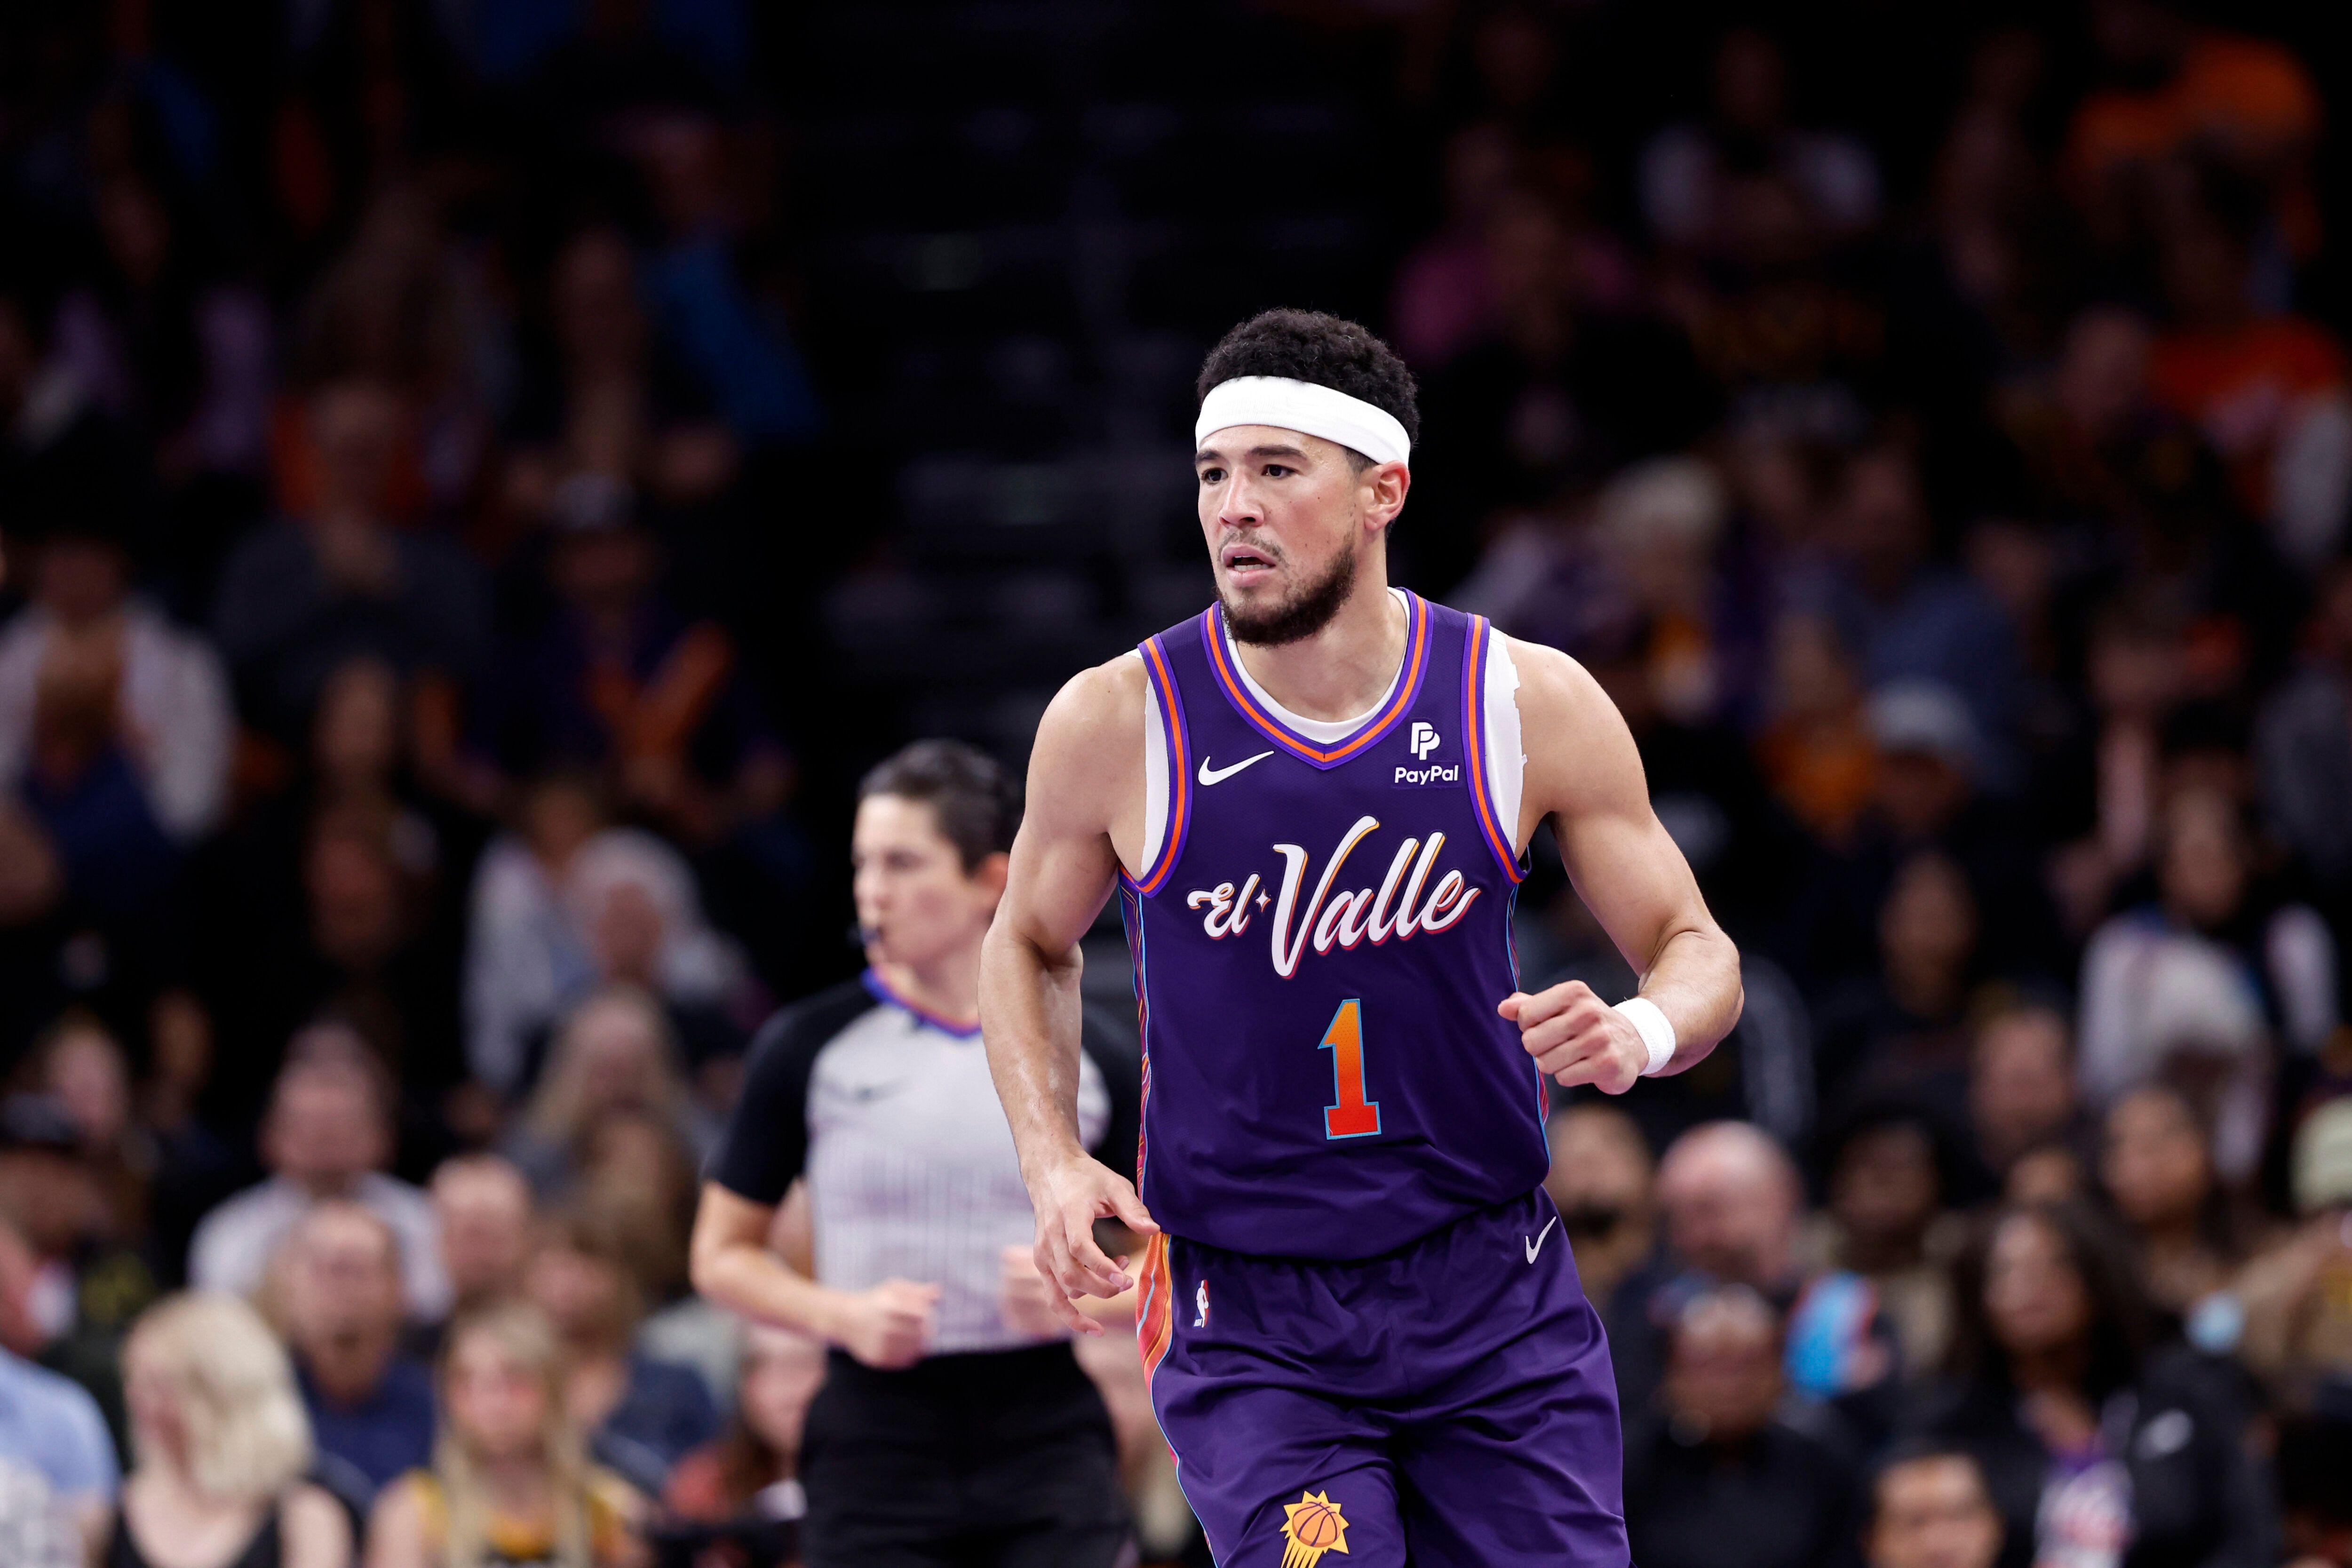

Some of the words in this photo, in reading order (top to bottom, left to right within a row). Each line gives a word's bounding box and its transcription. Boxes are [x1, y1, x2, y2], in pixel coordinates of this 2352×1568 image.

[1394, 765, 1459, 785] PayPal
[1187, 872, 1261, 939] El
[1272, 815, 1481, 979] Valle
[1317, 998, 1382, 1140] 1
